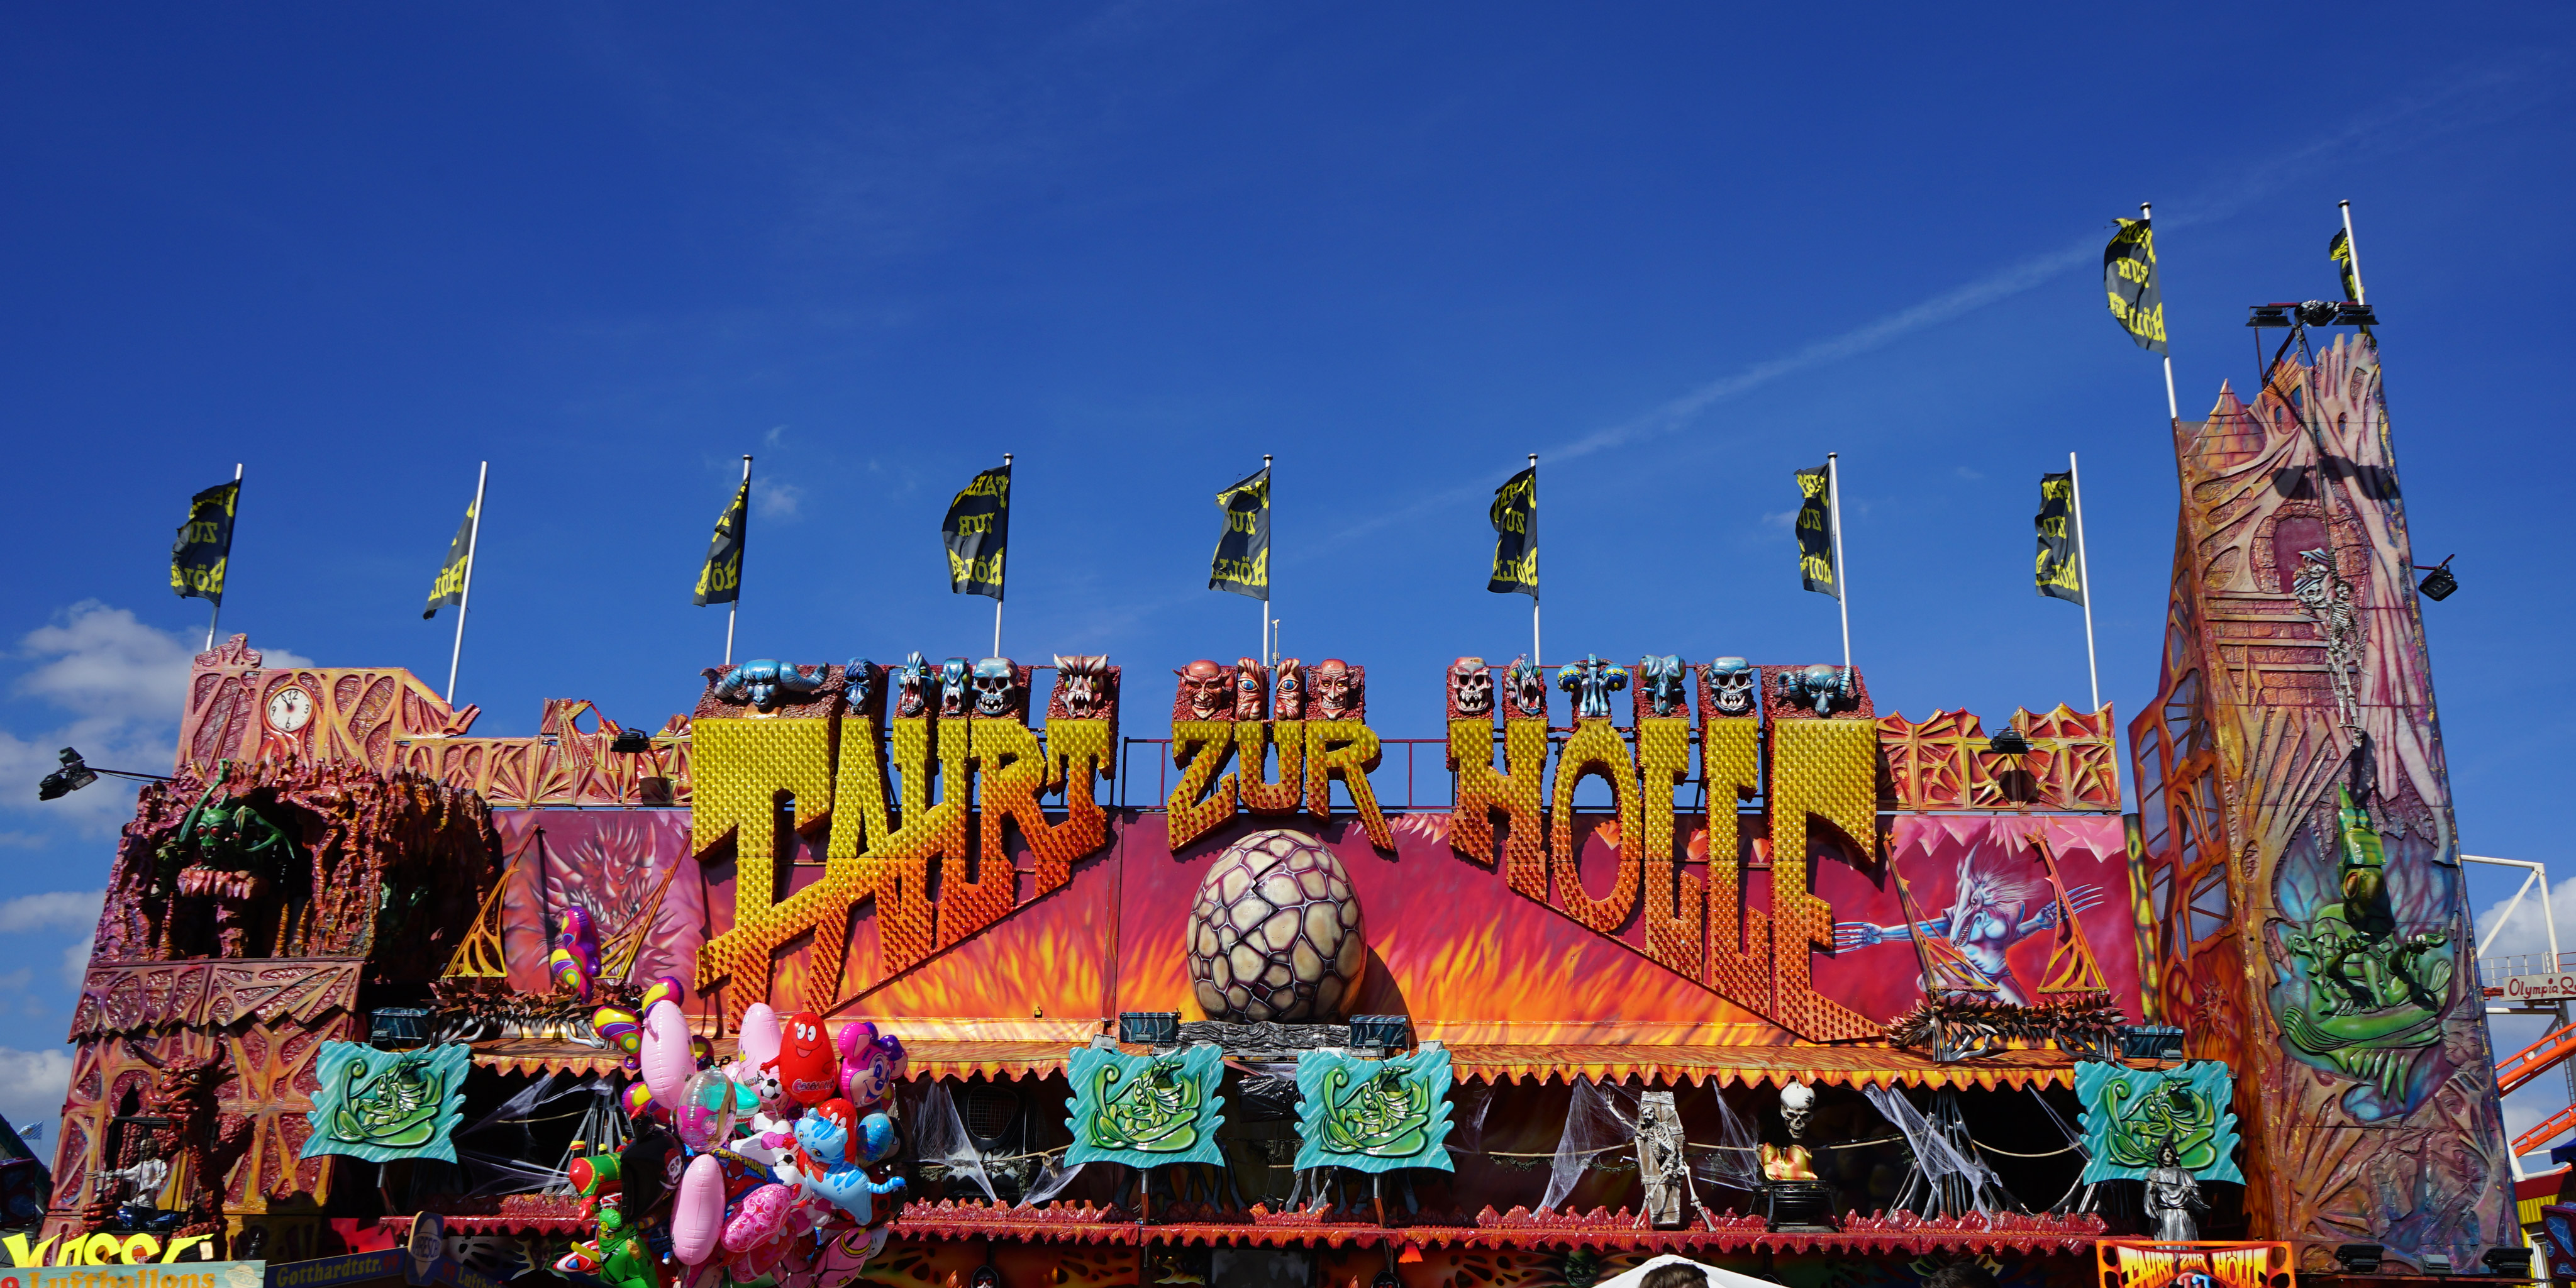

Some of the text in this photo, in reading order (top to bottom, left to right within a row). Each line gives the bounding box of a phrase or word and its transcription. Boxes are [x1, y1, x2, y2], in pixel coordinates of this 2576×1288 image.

[287, 691, 299, 700] 12
[304, 704, 309, 714] 3
[691, 718, 1113, 1033] FAHRT
[1168, 719, 1396, 852] ZUR
[2509, 978, 2558, 999] Olympia
[277, 1257, 382, 1287] Gotthardtstr.
[2117, 1245, 2268, 1288] FAHRT ZUR HÖLLE
